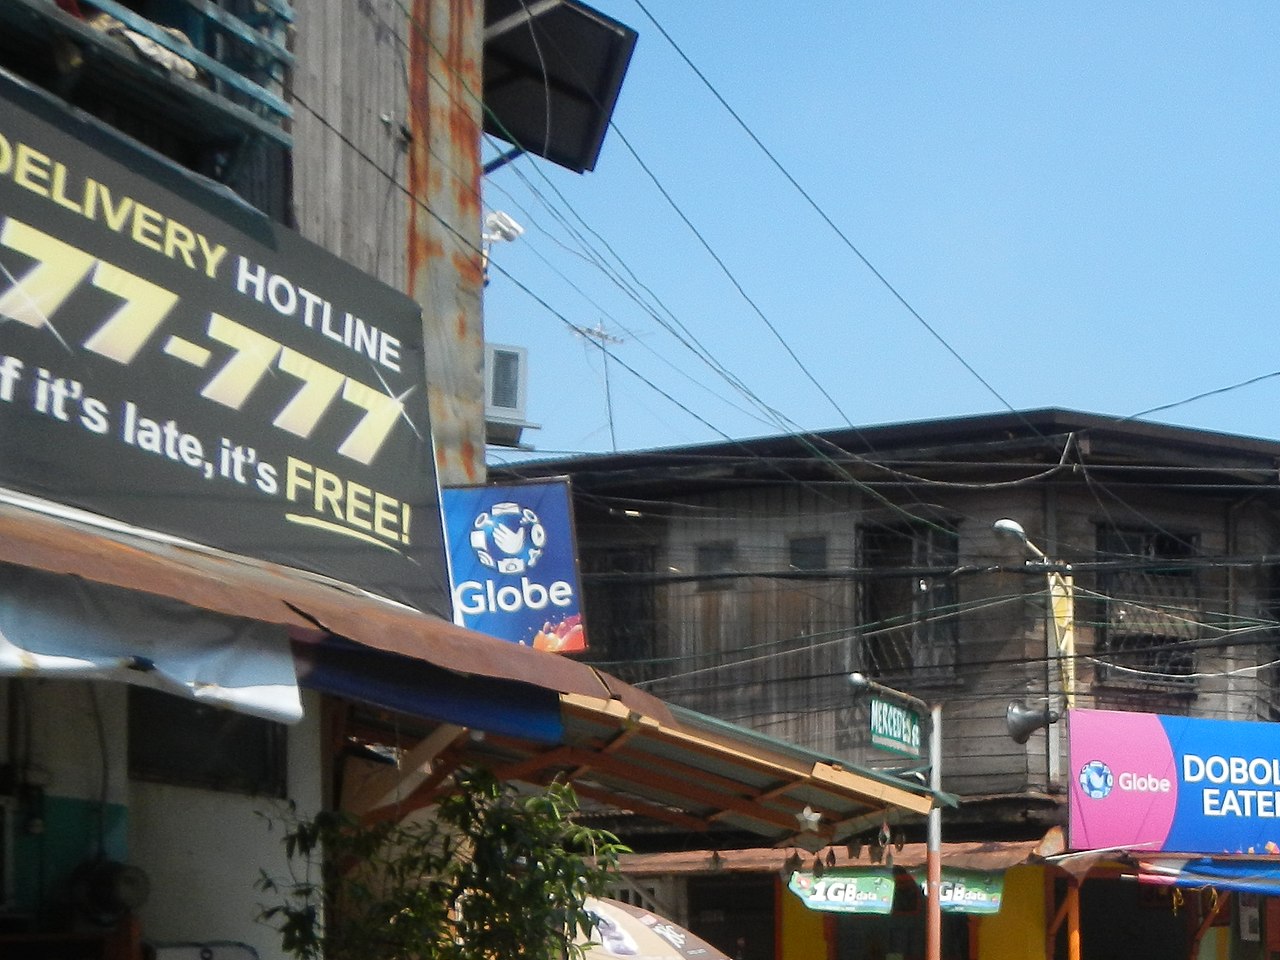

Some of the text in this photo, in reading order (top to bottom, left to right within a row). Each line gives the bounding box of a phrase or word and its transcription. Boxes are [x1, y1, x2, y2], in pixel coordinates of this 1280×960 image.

[0, 216, 404, 466] 77-777
[236, 255, 402, 373] HOTLINE
[34, 367, 110, 435] it's
[122, 400, 215, 480] late,
[219, 437, 279, 495] it's
[285, 455, 412, 545] FREE!
[455, 576, 574, 615] Globe
[1118, 771, 1172, 794] Globe
[808, 881, 878, 902] 1GB data
